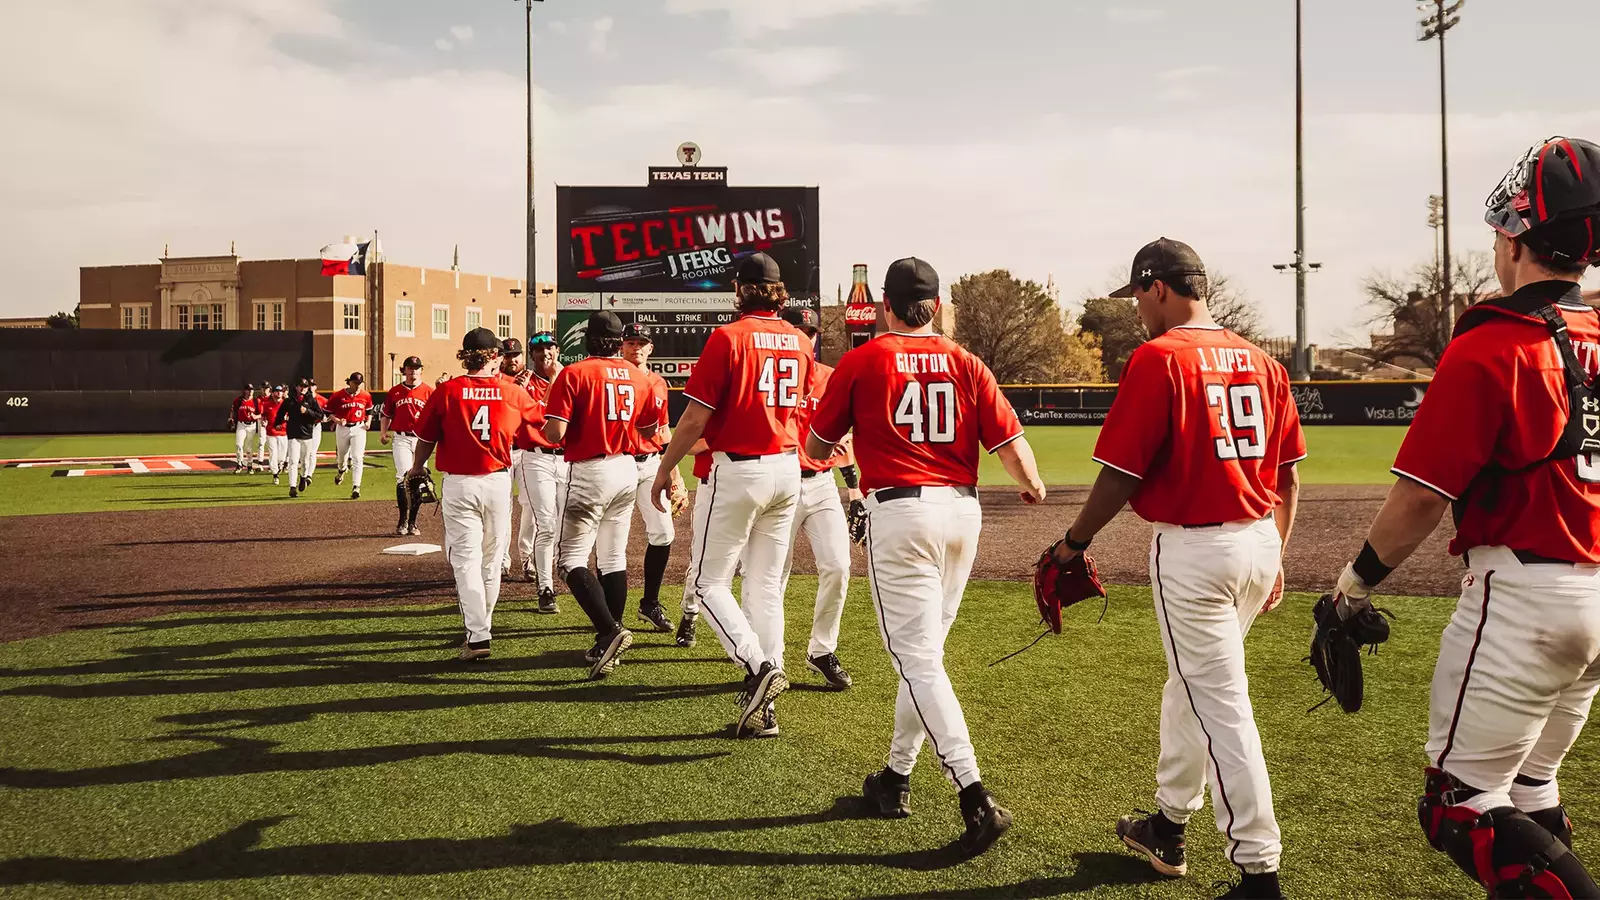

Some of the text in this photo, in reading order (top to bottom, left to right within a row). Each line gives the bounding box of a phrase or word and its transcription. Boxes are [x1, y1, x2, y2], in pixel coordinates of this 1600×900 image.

[652, 171, 724, 180] TEXAS TECH
[679, 247, 732, 272] FERG
[682, 265, 726, 280] ROOFING
[785, 296, 815, 307] eliant.
[638, 313, 732, 322] BALL STRIKE OUT
[895, 352, 950, 374] GIRTON
[1197, 347, 1256, 373] J. LOPEZ
[757, 355, 799, 408] 42
[6, 396, 29, 407] 402
[462, 387, 503, 401] BAZZELL
[605, 382, 635, 421] 13
[894, 381, 956, 443] 40
[1033, 411, 1063, 419] CanTex
[1365, 406, 1395, 419] Vista
[471, 404, 491, 441] 4
[1205, 383, 1266, 460] 39
